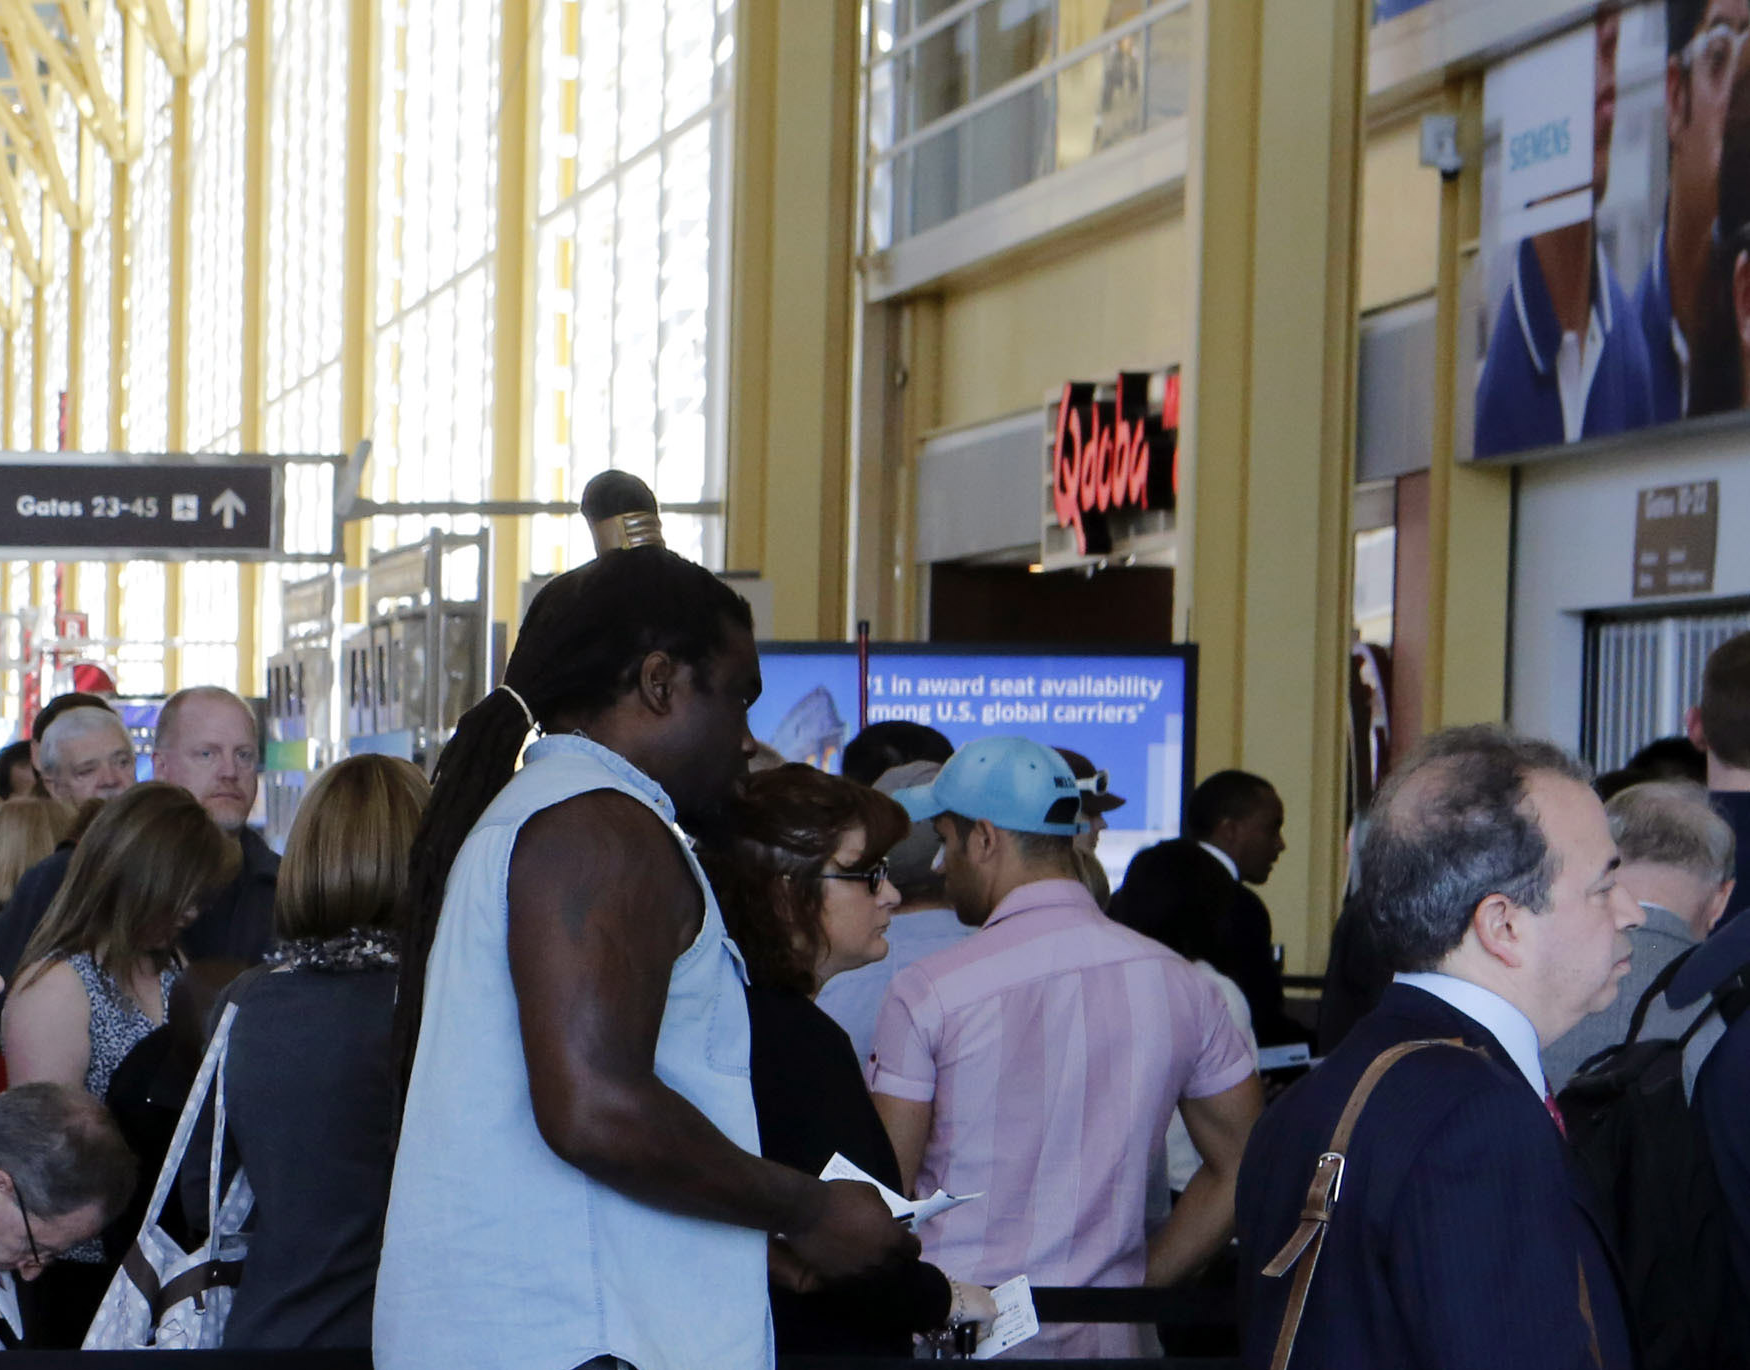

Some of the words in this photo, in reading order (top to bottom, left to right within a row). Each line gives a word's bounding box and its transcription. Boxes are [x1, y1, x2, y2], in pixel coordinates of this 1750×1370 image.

[1508, 117, 1571, 172] SIEMENS
[1053, 372, 1149, 556] Qdoba
[16, 494, 84, 517] Gates
[91, 496, 159, 518] 23-45
[891, 674, 912, 696] in
[917, 674, 985, 697] award
[990, 677, 1036, 697] seat
[1040, 674, 1164, 701] availability
[936, 702, 977, 722] U.S.
[982, 701, 1049, 725] global
